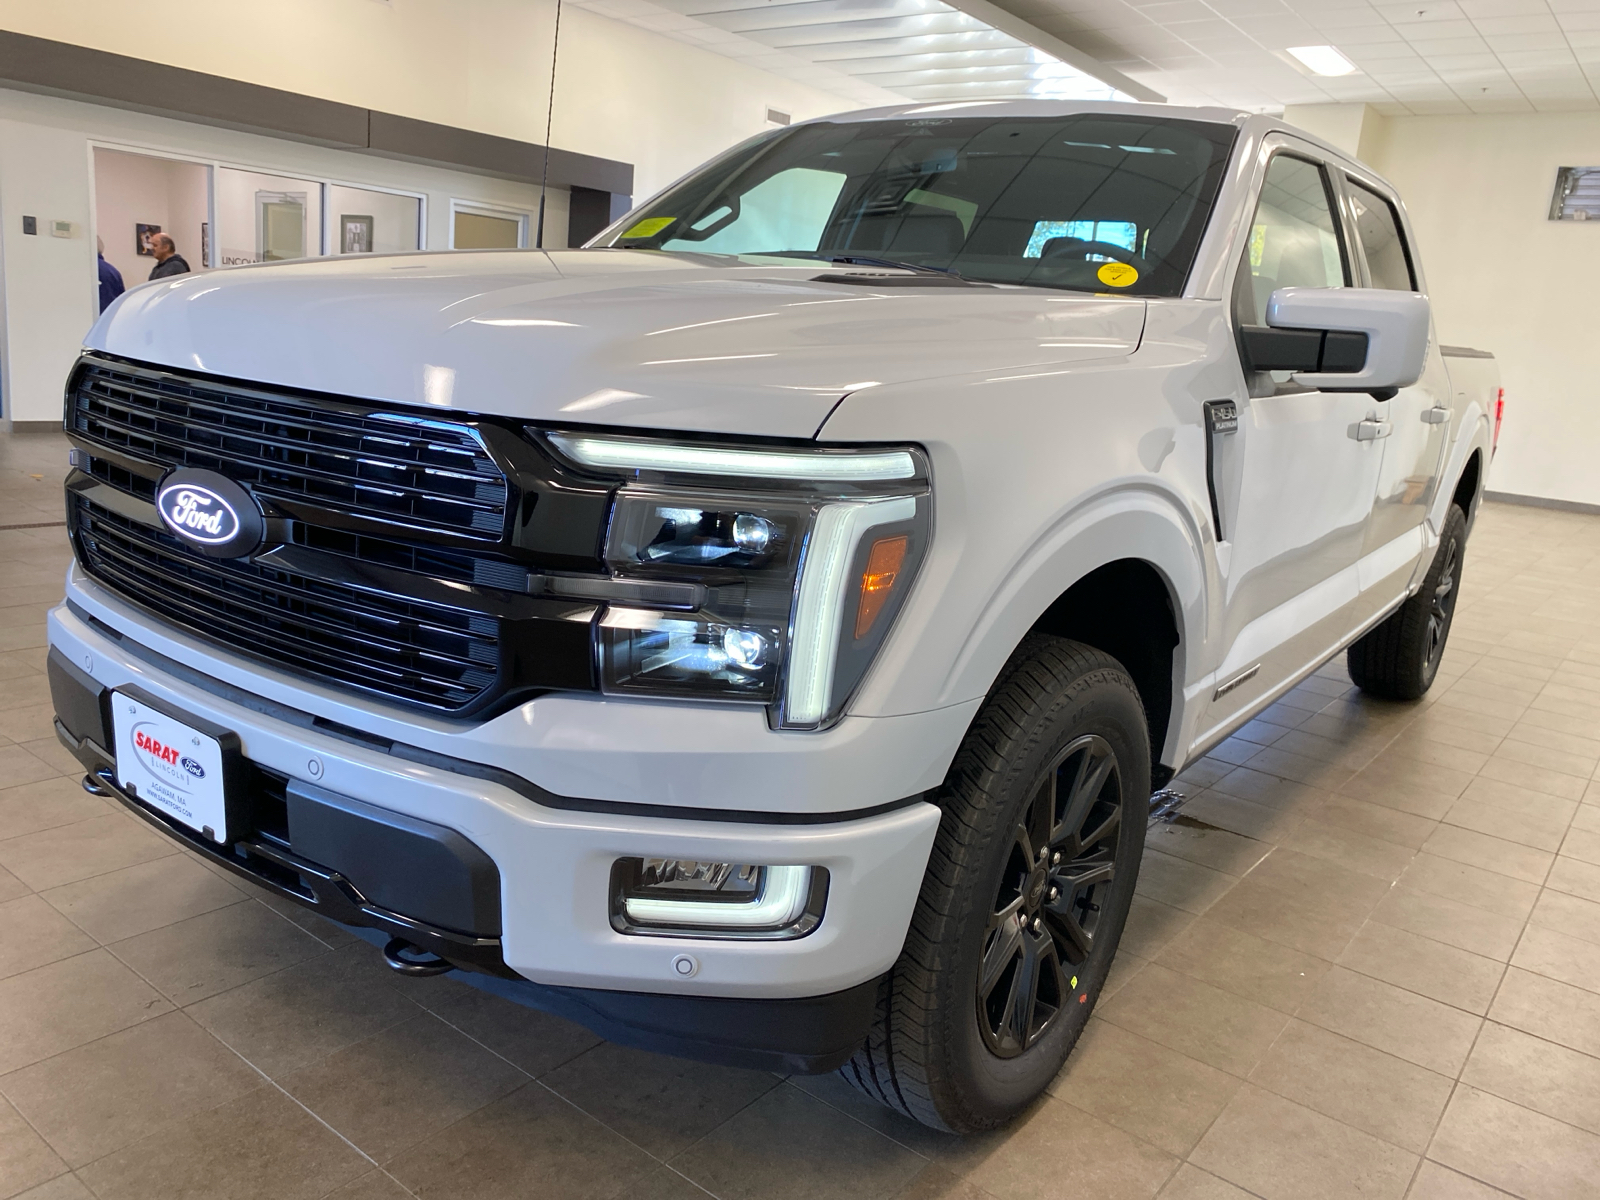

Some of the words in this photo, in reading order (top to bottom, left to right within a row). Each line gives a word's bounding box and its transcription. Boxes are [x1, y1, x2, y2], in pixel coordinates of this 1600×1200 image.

[172, 490, 224, 535] Ford
[135, 730, 180, 767] SARAT
[184, 759, 202, 776] Ford
[155, 761, 185, 781] LINCOLN
[177, 795, 187, 807] MA
